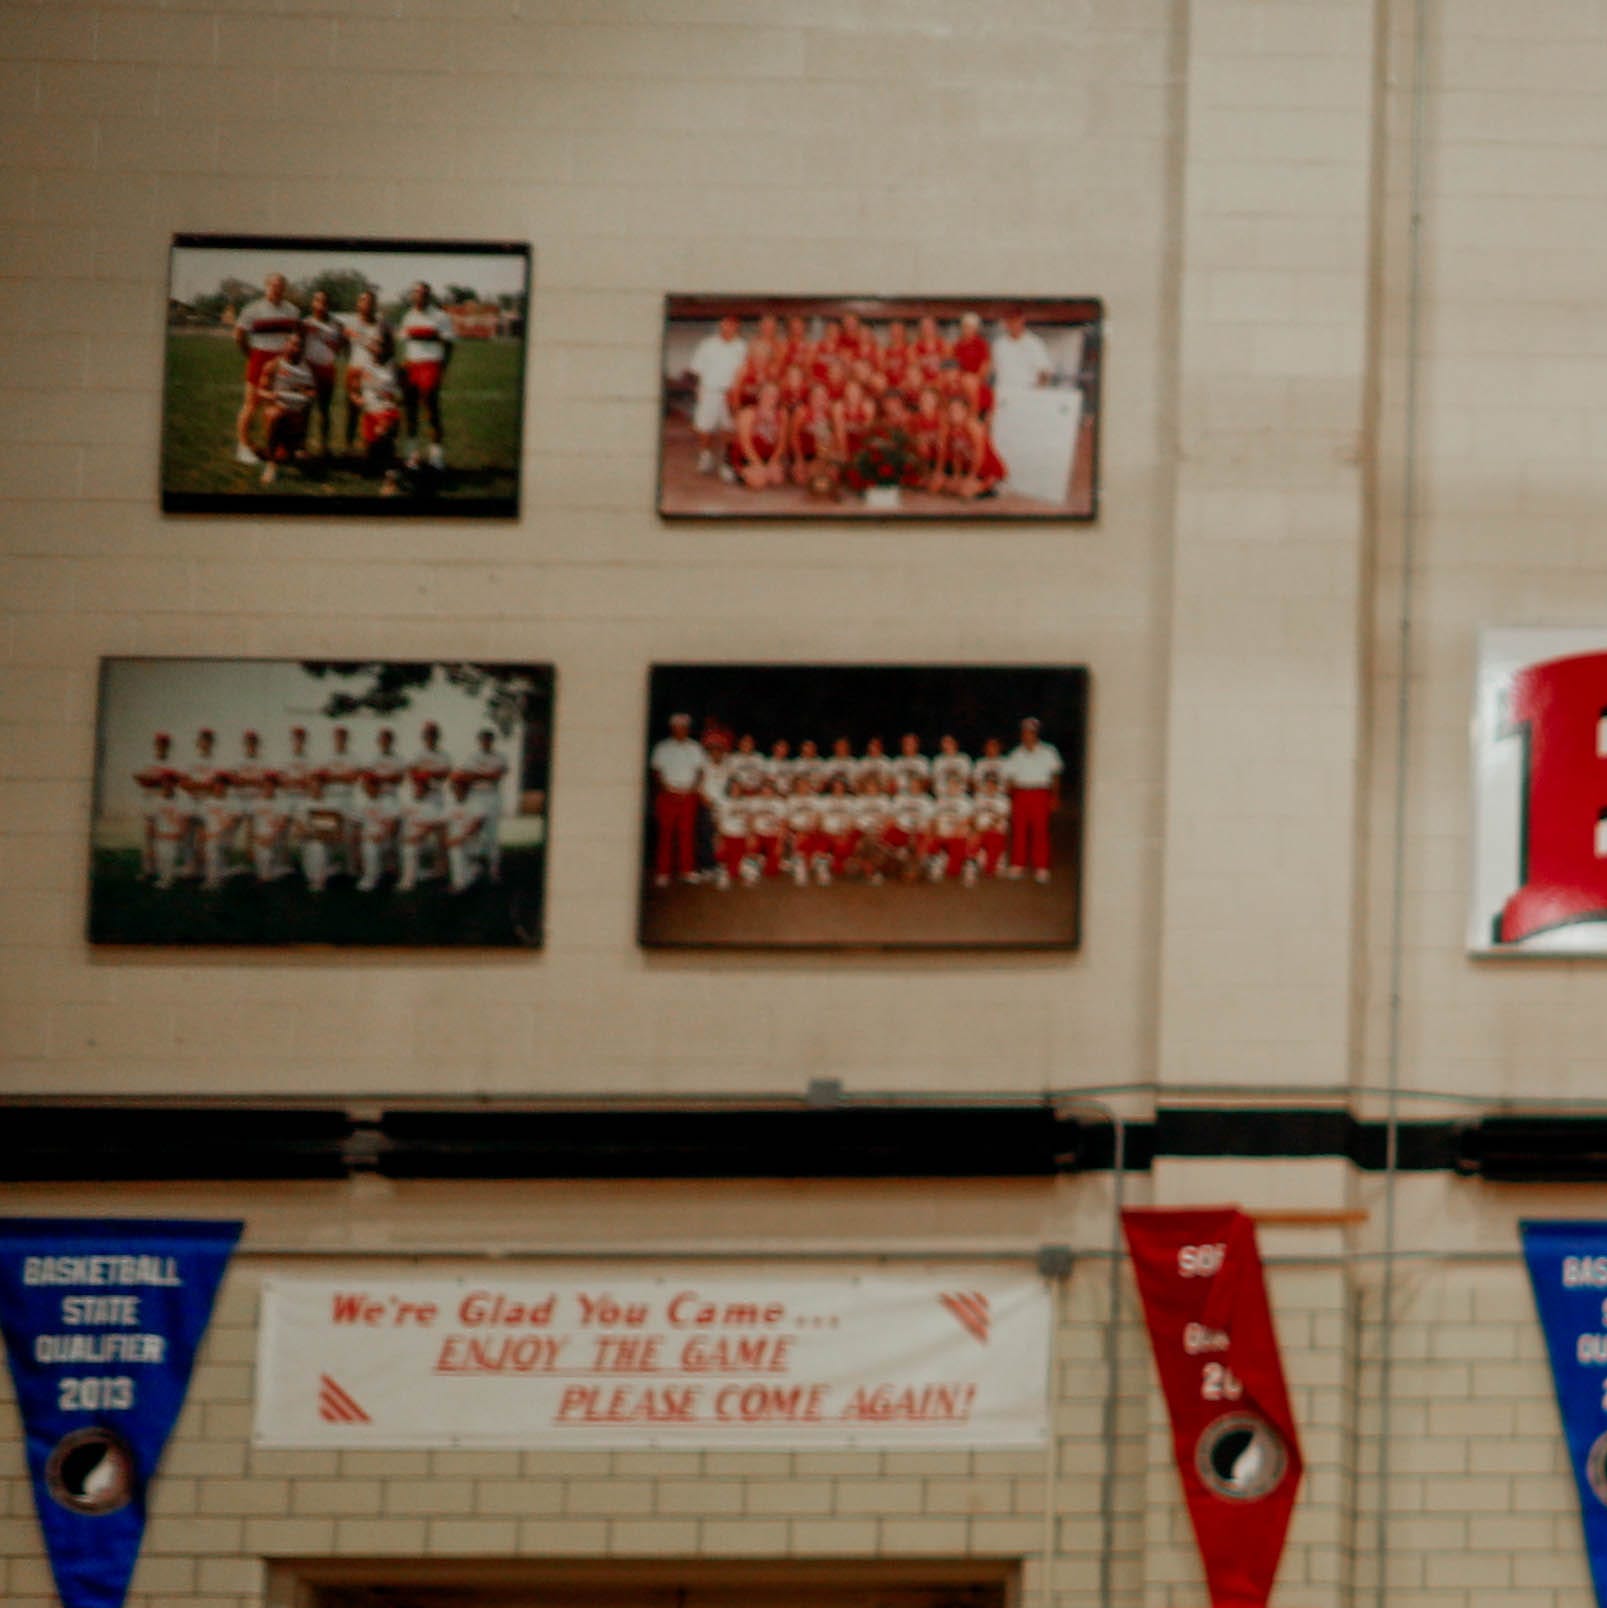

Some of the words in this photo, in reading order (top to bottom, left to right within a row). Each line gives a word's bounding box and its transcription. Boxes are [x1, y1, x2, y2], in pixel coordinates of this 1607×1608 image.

[23, 1256, 182, 1286] BASKETBALL
[61, 1295, 142, 1326] STATE
[331, 1292, 438, 1327] We're
[458, 1291, 557, 1327] Glad
[577, 1291, 649, 1328] You
[35, 1334, 166, 1363] QUALIFIER
[434, 1334, 568, 1373] ENJOY
[592, 1334, 665, 1373] THE
[681, 1334, 796, 1373] GAME
[57, 1376, 134, 1411] 2013
[554, 1384, 704, 1422] PLEASE
[714, 1383, 832, 1422] COME
[839, 1382, 977, 1422] AGAIN!
